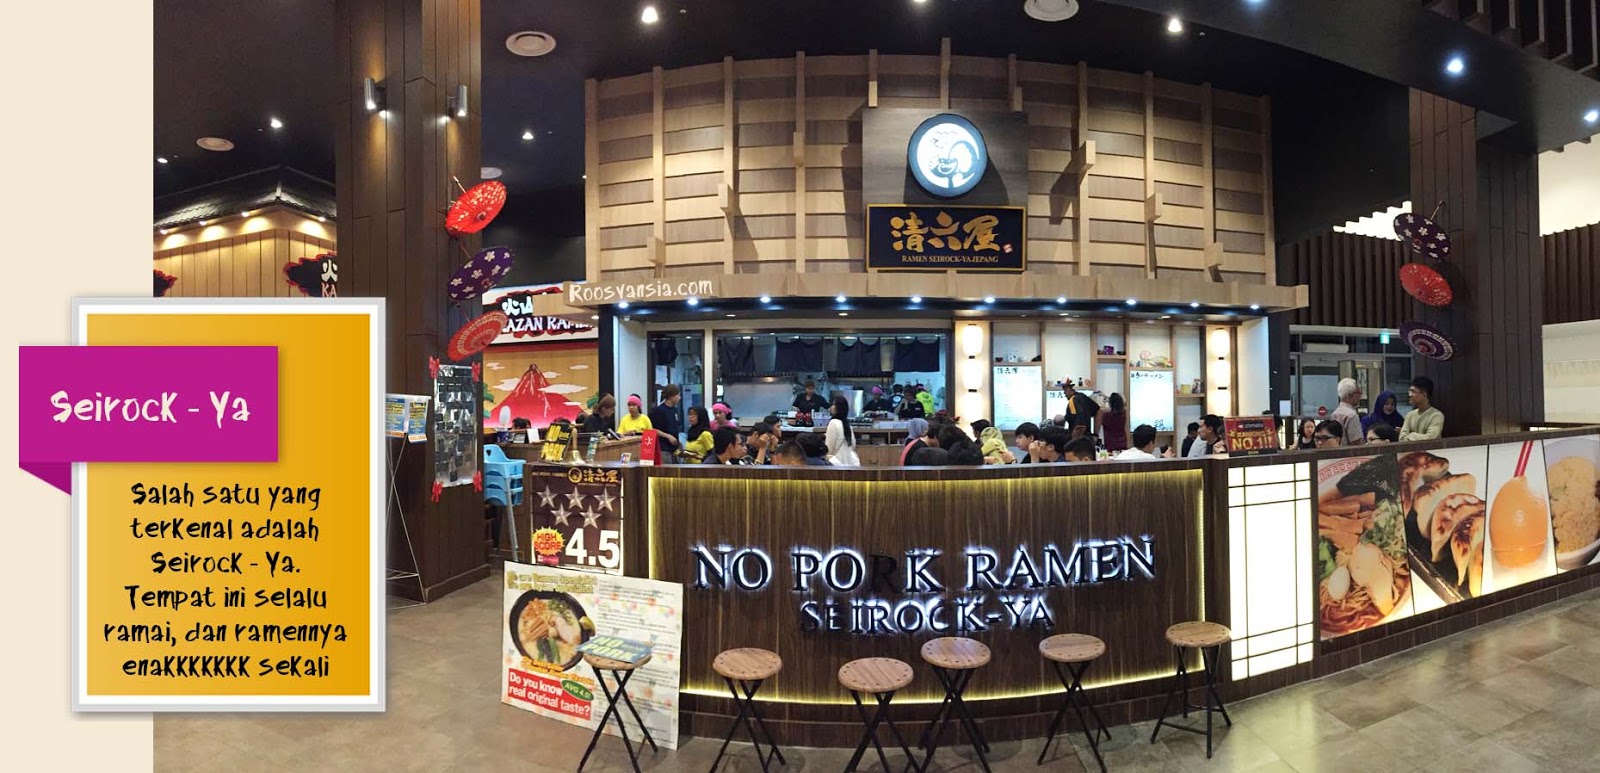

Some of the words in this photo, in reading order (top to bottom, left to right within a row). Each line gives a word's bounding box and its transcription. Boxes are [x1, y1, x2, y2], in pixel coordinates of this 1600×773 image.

[889, 211, 1000, 253] 清六屋
[503, 317, 543, 332] AZAN
[534, 541, 561, 551] SCORE
[536, 533, 557, 541] HIGH
[565, 528, 620, 569] 4.5
[692, 545, 772, 592] NO
[790, 546, 946, 593] PORK
[964, 536, 1156, 593] RAMEN
[801, 595, 1055, 634] SEIROCK-YA
[509, 671, 521, 684] Do
[523, 677, 538, 690] you
[539, 680, 563, 696] know
[509, 686, 526, 698] real
[528, 691, 559, 708] original
[561, 700, 591, 716] taste?
